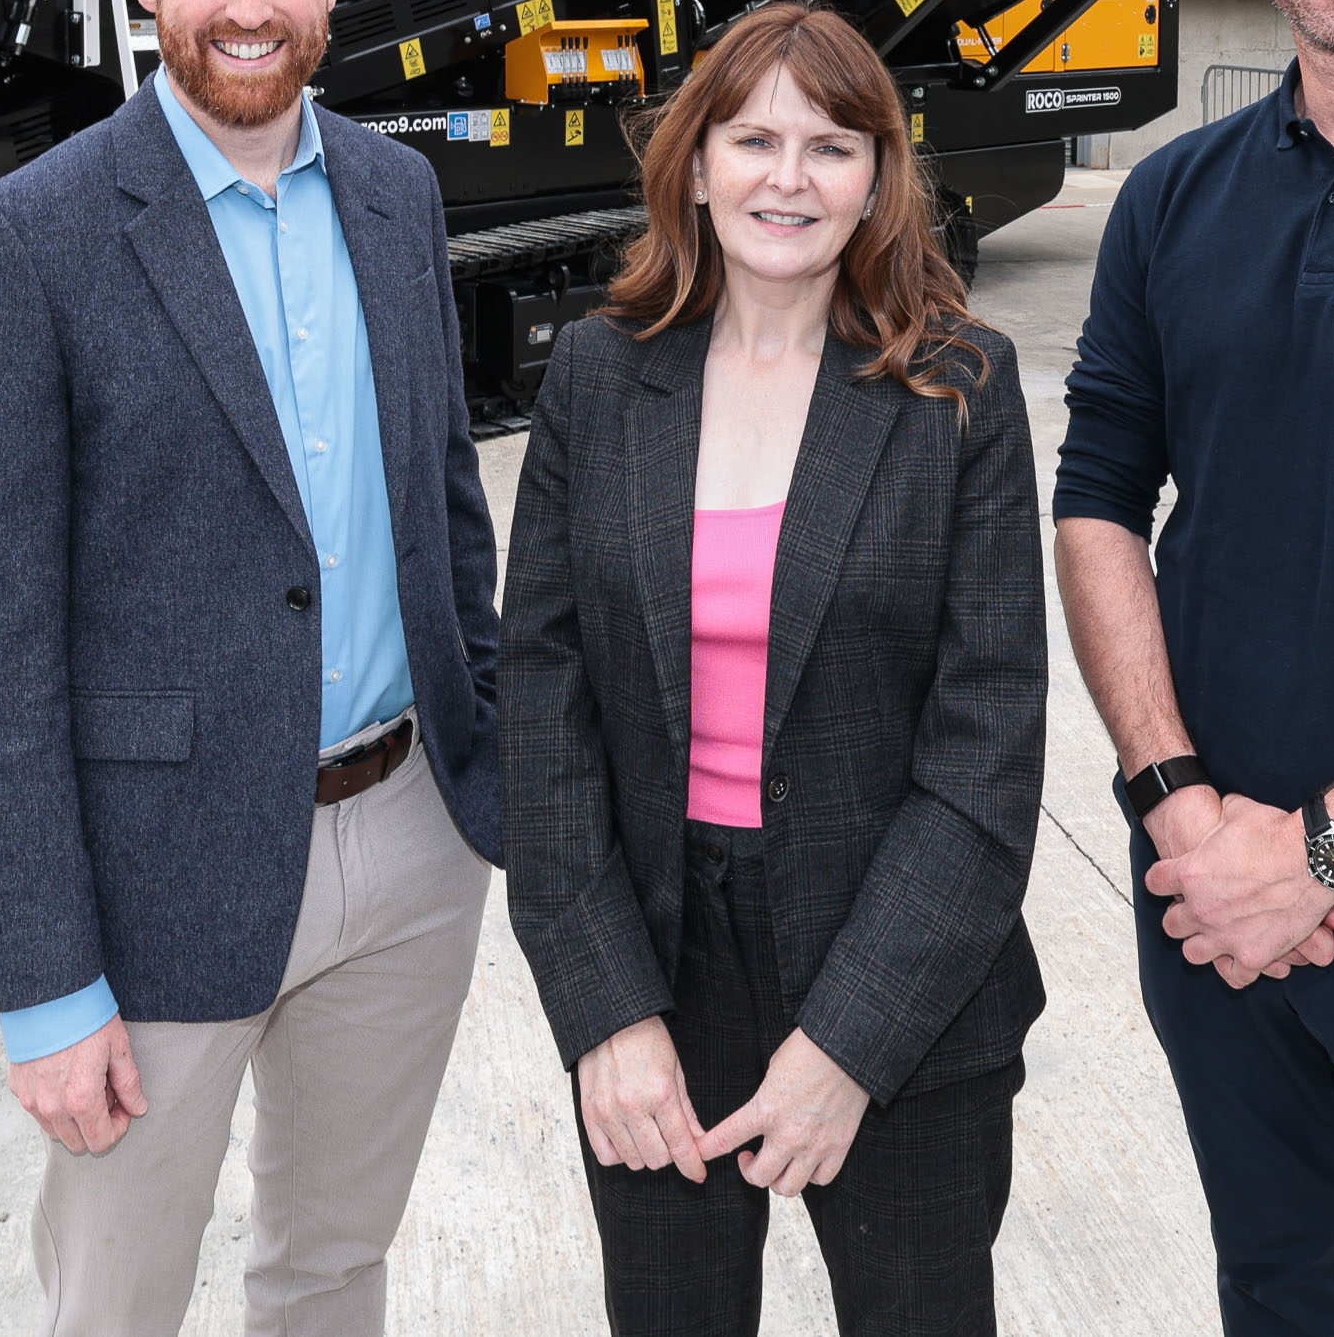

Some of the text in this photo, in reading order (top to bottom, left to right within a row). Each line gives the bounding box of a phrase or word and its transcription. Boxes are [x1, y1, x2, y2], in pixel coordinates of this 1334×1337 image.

[957, 37, 1003, 47] DUAL-ER
[1028, 92, 1119, 110] ROCO SPRINTER 1500
